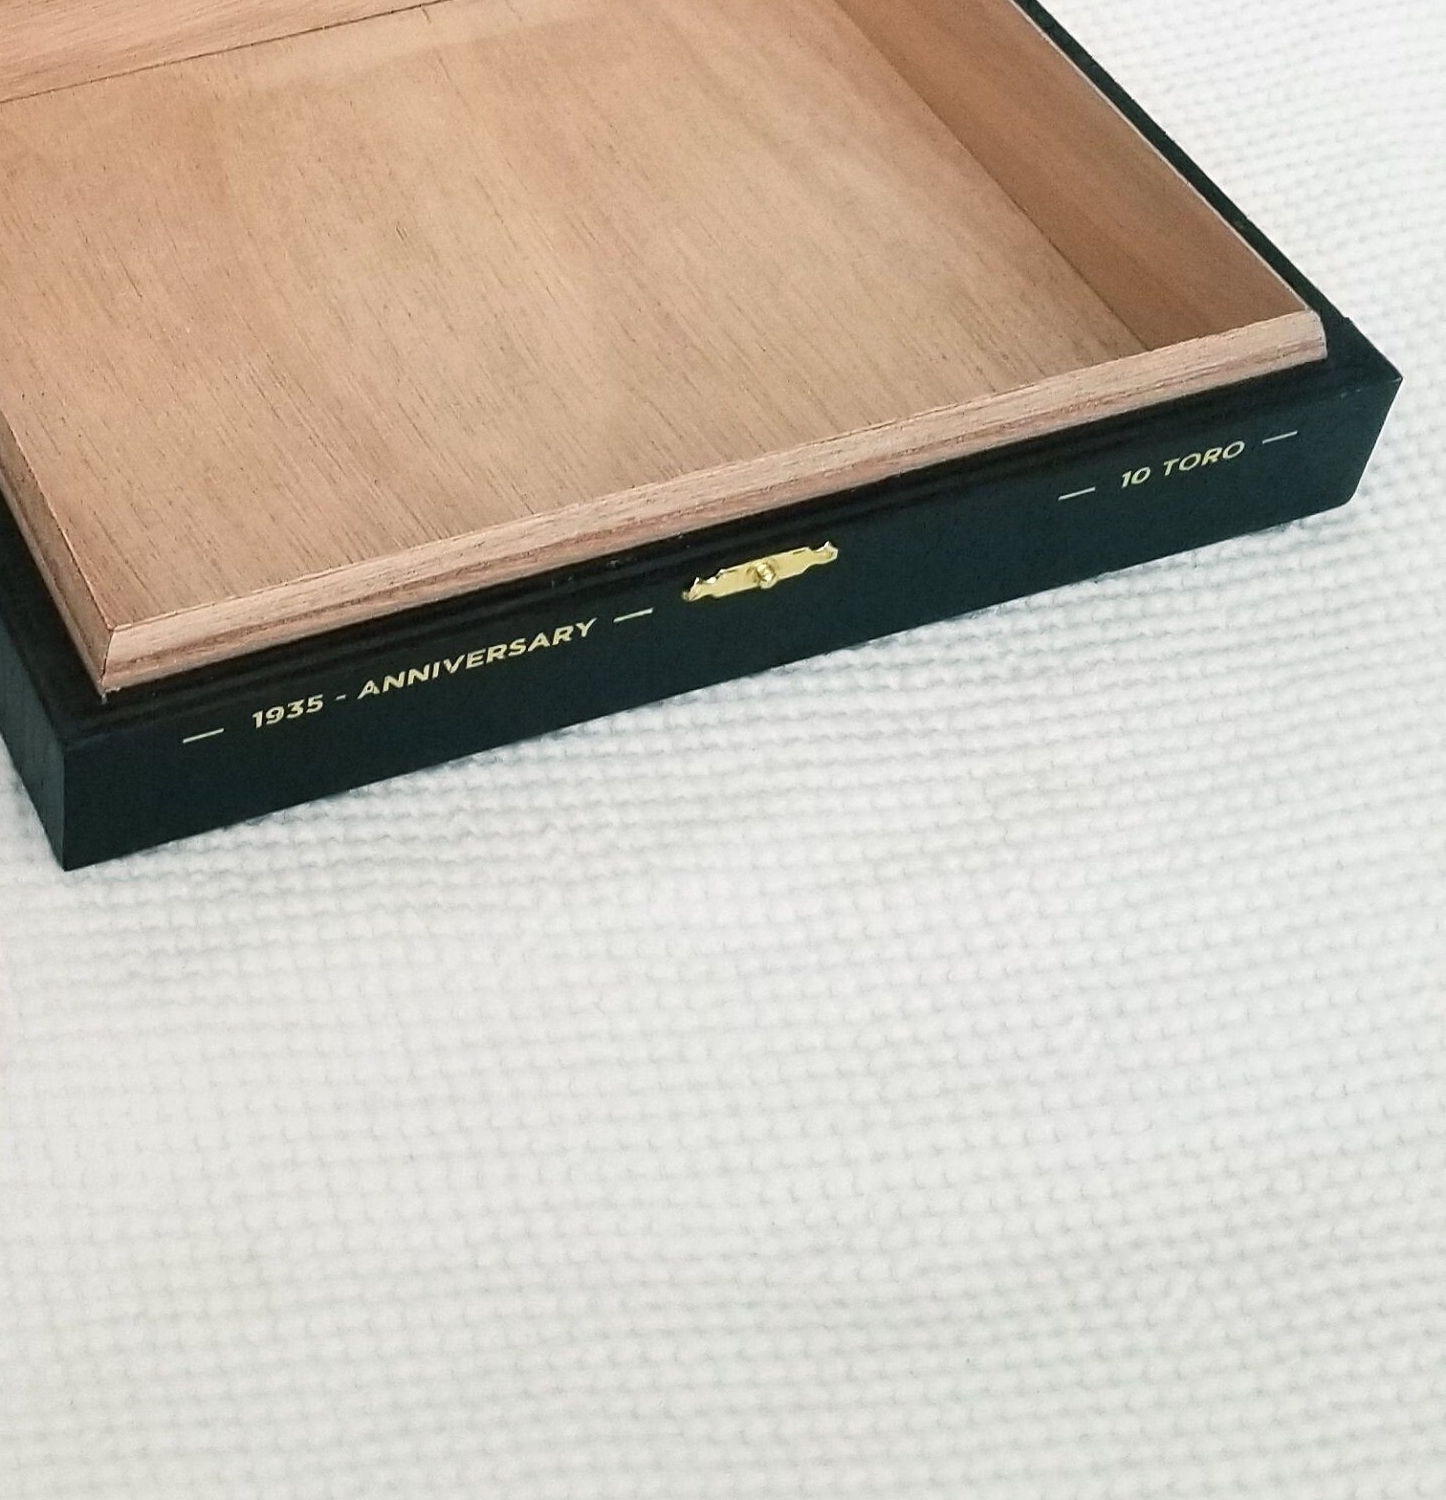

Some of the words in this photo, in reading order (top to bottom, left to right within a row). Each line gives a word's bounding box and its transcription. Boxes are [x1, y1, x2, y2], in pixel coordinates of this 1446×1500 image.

[1120, 465, 1152, 489] 10
[1162, 440, 1246, 477] TORO
[252, 693, 325, 730] 1935
[356, 617, 598, 700] ANNIVERSARY
